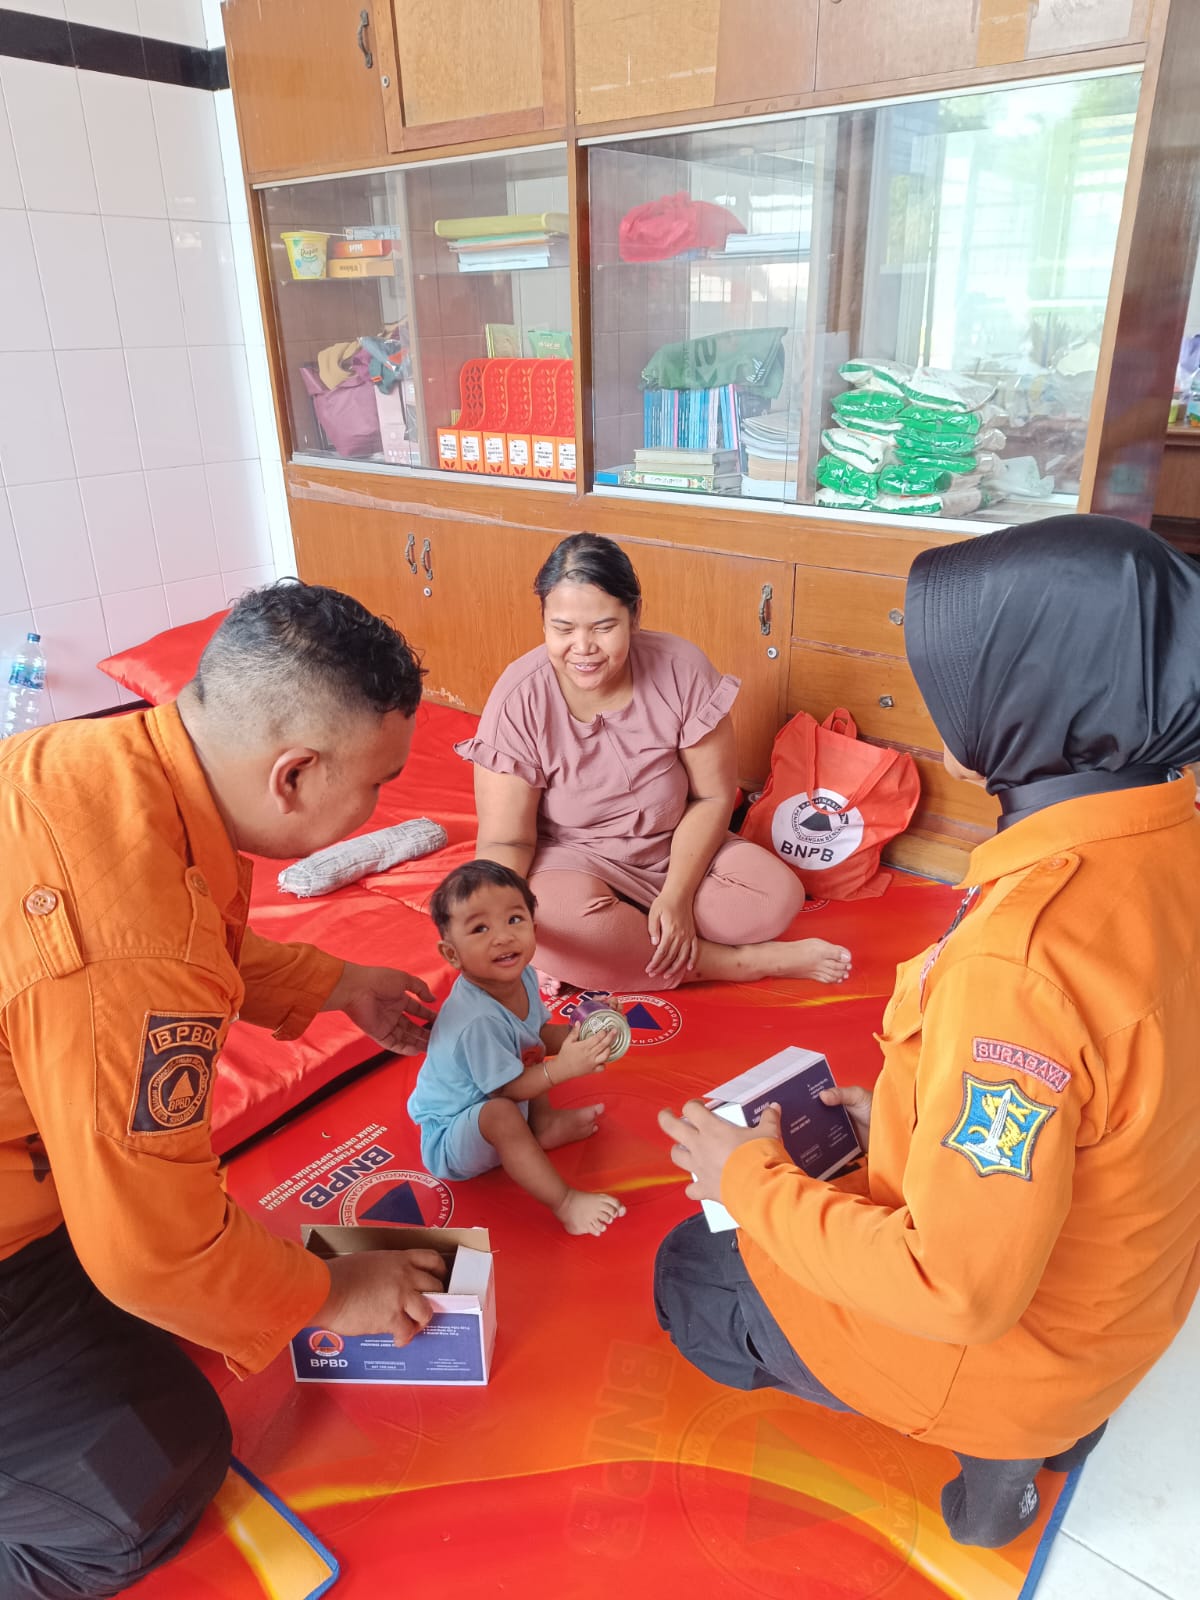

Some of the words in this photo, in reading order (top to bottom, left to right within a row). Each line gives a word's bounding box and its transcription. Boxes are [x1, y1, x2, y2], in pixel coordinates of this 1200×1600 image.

[780, 840, 834, 862] BNPB
[156, 1026, 212, 1046] BPBD
[978, 1043, 1064, 1089] SURABAYA
[354, 1126, 388, 1150] BANTUAN
[358, 1123, 379, 1139] TIDAK
[334, 1134, 358, 1155] UNTUK
[294, 1151, 334, 1181] DIPERJUAL
[300, 1145, 395, 1209] BNPB
[309, 1147, 356, 1181] PEMERINTAH
[258, 1180, 294, 1206] BELIKAN
[265, 1180, 309, 1211] INDONESIA
[436, 1186, 449, 1220] BADAN
[310, 1358, 349, 1368] BPBD
